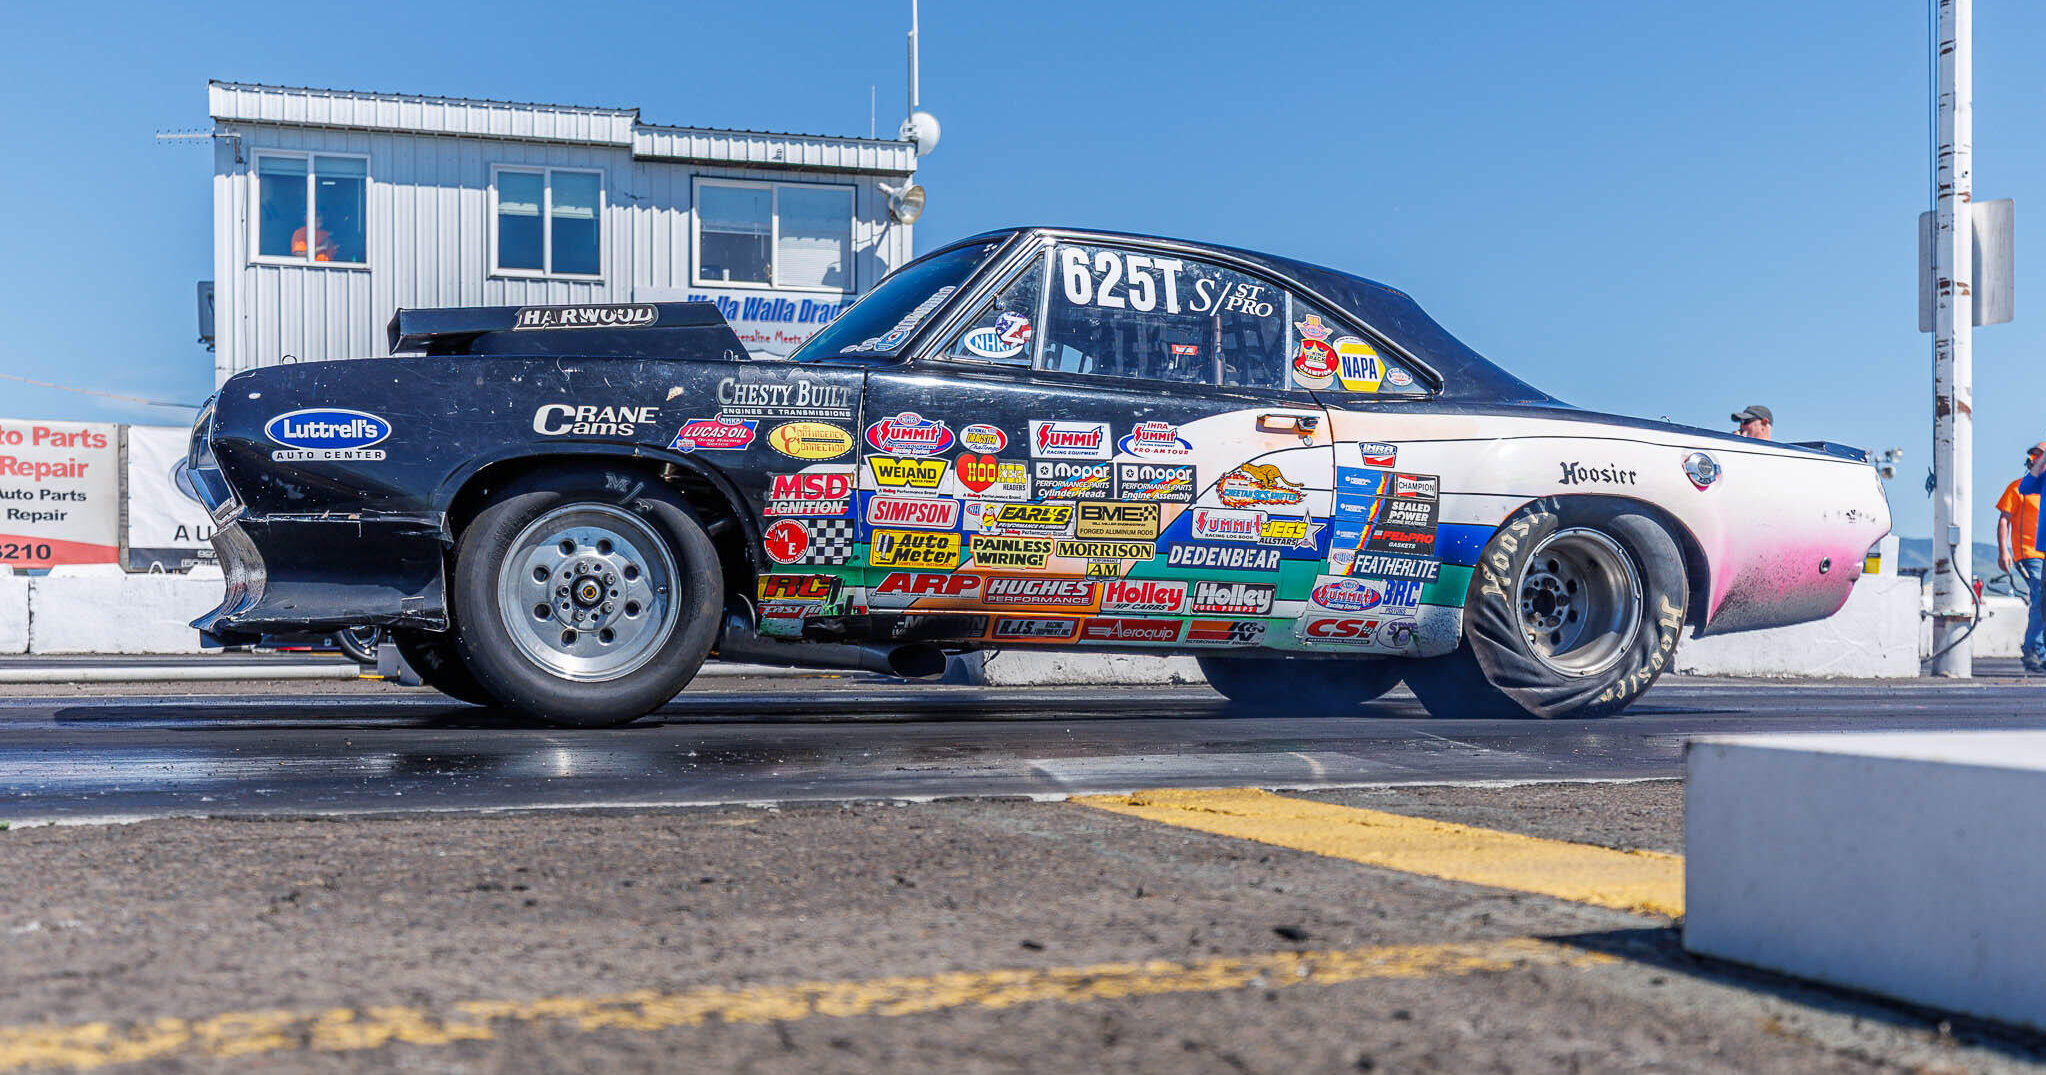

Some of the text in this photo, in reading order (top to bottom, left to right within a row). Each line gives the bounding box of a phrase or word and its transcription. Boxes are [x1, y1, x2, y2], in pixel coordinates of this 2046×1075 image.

[1061, 248, 1184, 314] 625T
[1233, 282, 1266, 301] ST
[742, 296, 796, 323] Walla
[1224, 295, 1274, 317] PRO
[523, 307, 654, 325] HARWOOD
[1341, 356, 1378, 380] NAPA
[718, 377, 852, 408] CHESTY BUILT
[722, 407, 762, 416] ENGINES
[779, 409, 852, 418] TRANSMISSIONS
[283, 419, 379, 439] Luttrell's
[683, 426, 749, 439] LUCAS OIL
[1147, 422, 1169, 430] IHRA
[32, 426, 108, 449] Parts
[966, 432, 998, 445] DRAGSTER
[276, 451, 383, 460] AUTO CENTER
[0, 455, 89, 482] Repair
[878, 465, 938, 480] WEIAND
[966, 462, 1027, 484] HOOKER
[1559, 461, 1637, 486] Hoosier
[772, 474, 849, 500] MSD
[1002, 483, 1027, 491] HEADERS
[1035, 479, 1111, 489] PERFORMANCE PARTS
[1121, 482, 1171, 490] PERFORMANCE
[1398, 481, 1436, 491] CHAMPION
[39, 488, 88, 502] Parts
[1037, 488, 1107, 499] Cylinder Heads
[1121, 491, 1193, 502] Engine Assembly
[770, 501, 845, 514] IGNITION
[873, 500, 952, 524] SIMPSON
[999, 506, 1070, 522] EARL'S
[1080, 505, 1144, 522] BME
[1391, 501, 1431, 513] SEALED
[6, 508, 68, 524] Repair
[1388, 510, 1430, 523] POWER
[1079, 527, 1105, 535] FORGED
[1105, 528, 1137, 536] ALUMINUM
[1260, 520, 1309, 540] JEG'S
[899, 533, 950, 549] Auto
[973, 538, 1051, 553] PAINLESS
[1258, 537, 1297, 546] ALLSTARS
[1388, 541, 1416, 549] GASKETS
[893, 548, 958, 564] Meter
[1058, 542, 1153, 558] MORRISON
[1168, 544, 1281, 569] DEDENBEAR
[976, 552, 1045, 566] WIRING!
[1353, 554, 1441, 579] FEATHERLITE
[1088, 564, 1119, 577] AM
[876, 572, 981, 595] ARP
[987, 579, 1094, 596] HUGHES
[987, 595, 1090, 604] PERFORMANCE
[1105, 581, 1184, 612] Holley
[1196, 582, 1273, 614] Holley
[1382, 579, 1420, 607] BRC
[1131, 603, 1168, 611] CARBS
[1109, 619, 1174, 641] Aeroquip
[1306, 618, 1380, 639] CSI
